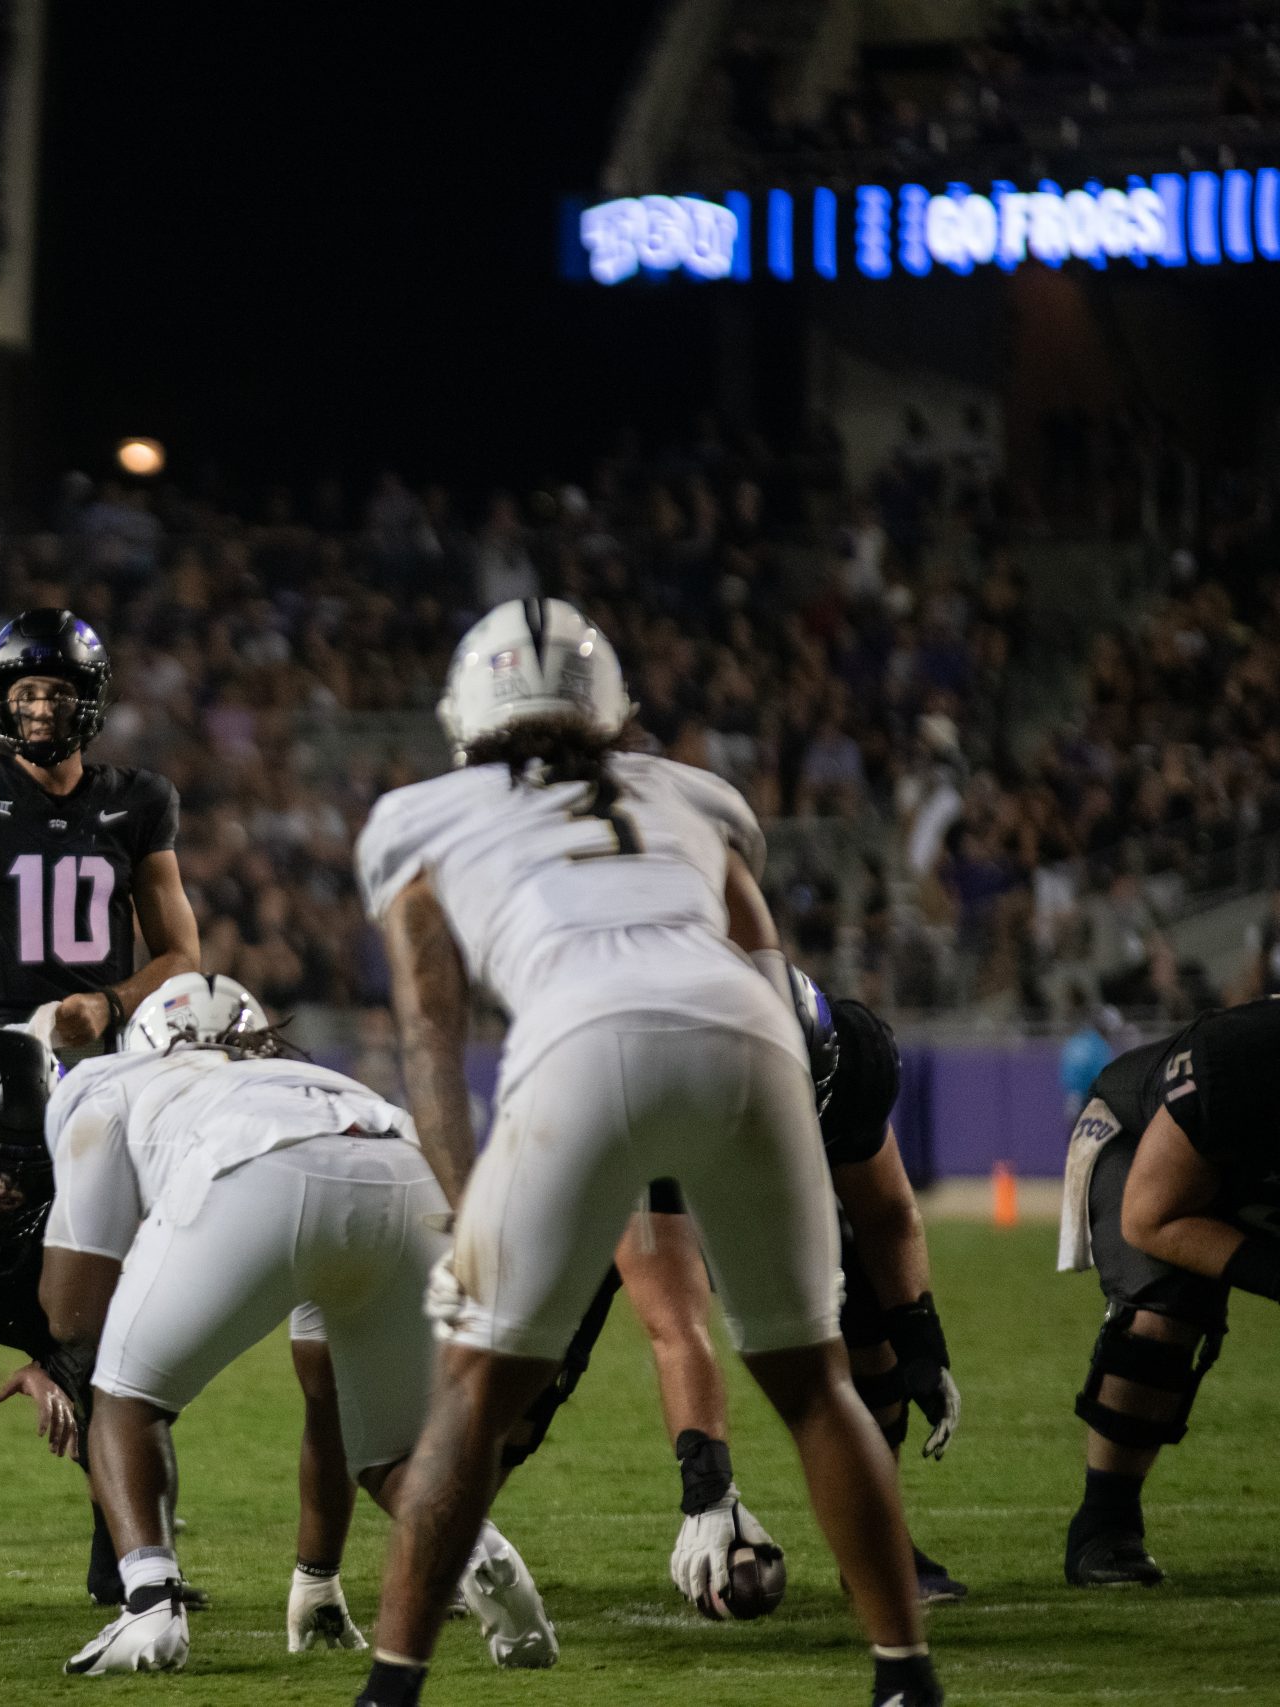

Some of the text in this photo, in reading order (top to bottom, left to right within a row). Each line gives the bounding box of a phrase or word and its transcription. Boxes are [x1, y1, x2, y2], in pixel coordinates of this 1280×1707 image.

[926, 187, 1169, 264] GO FROGS
[8, 853, 116, 963] 10
[1073, 1117, 1115, 1143] TCU
